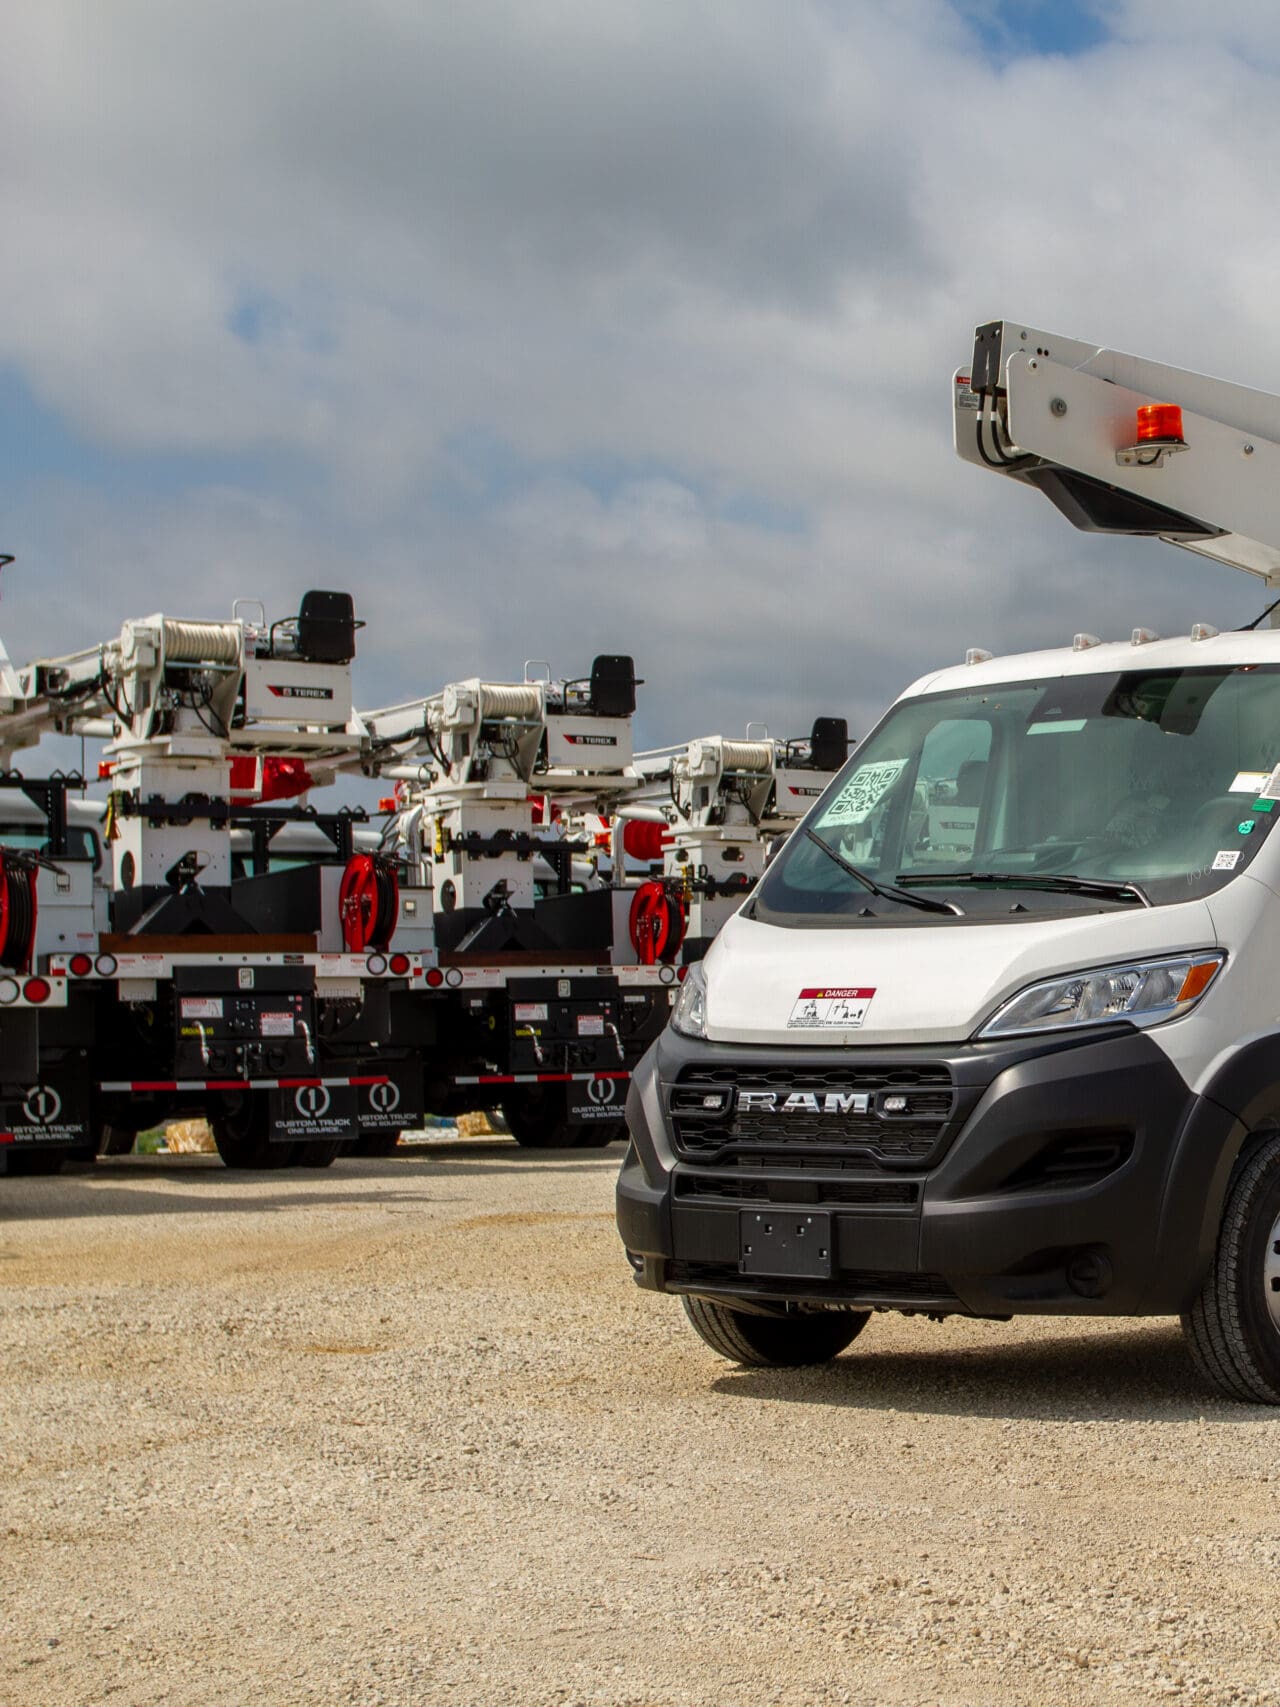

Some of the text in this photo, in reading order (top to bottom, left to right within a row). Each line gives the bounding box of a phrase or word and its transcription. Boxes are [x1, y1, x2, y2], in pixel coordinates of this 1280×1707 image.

[294, 687, 326, 698] TEREX
[824, 989, 859, 997] DANGER
[737, 1092, 871, 1114] RAM
[389, 1112, 418, 1120] TRUCK
[275, 1118, 351, 1128] CUSTOM TRUCK
[287, 1127, 305, 1135] ONE
